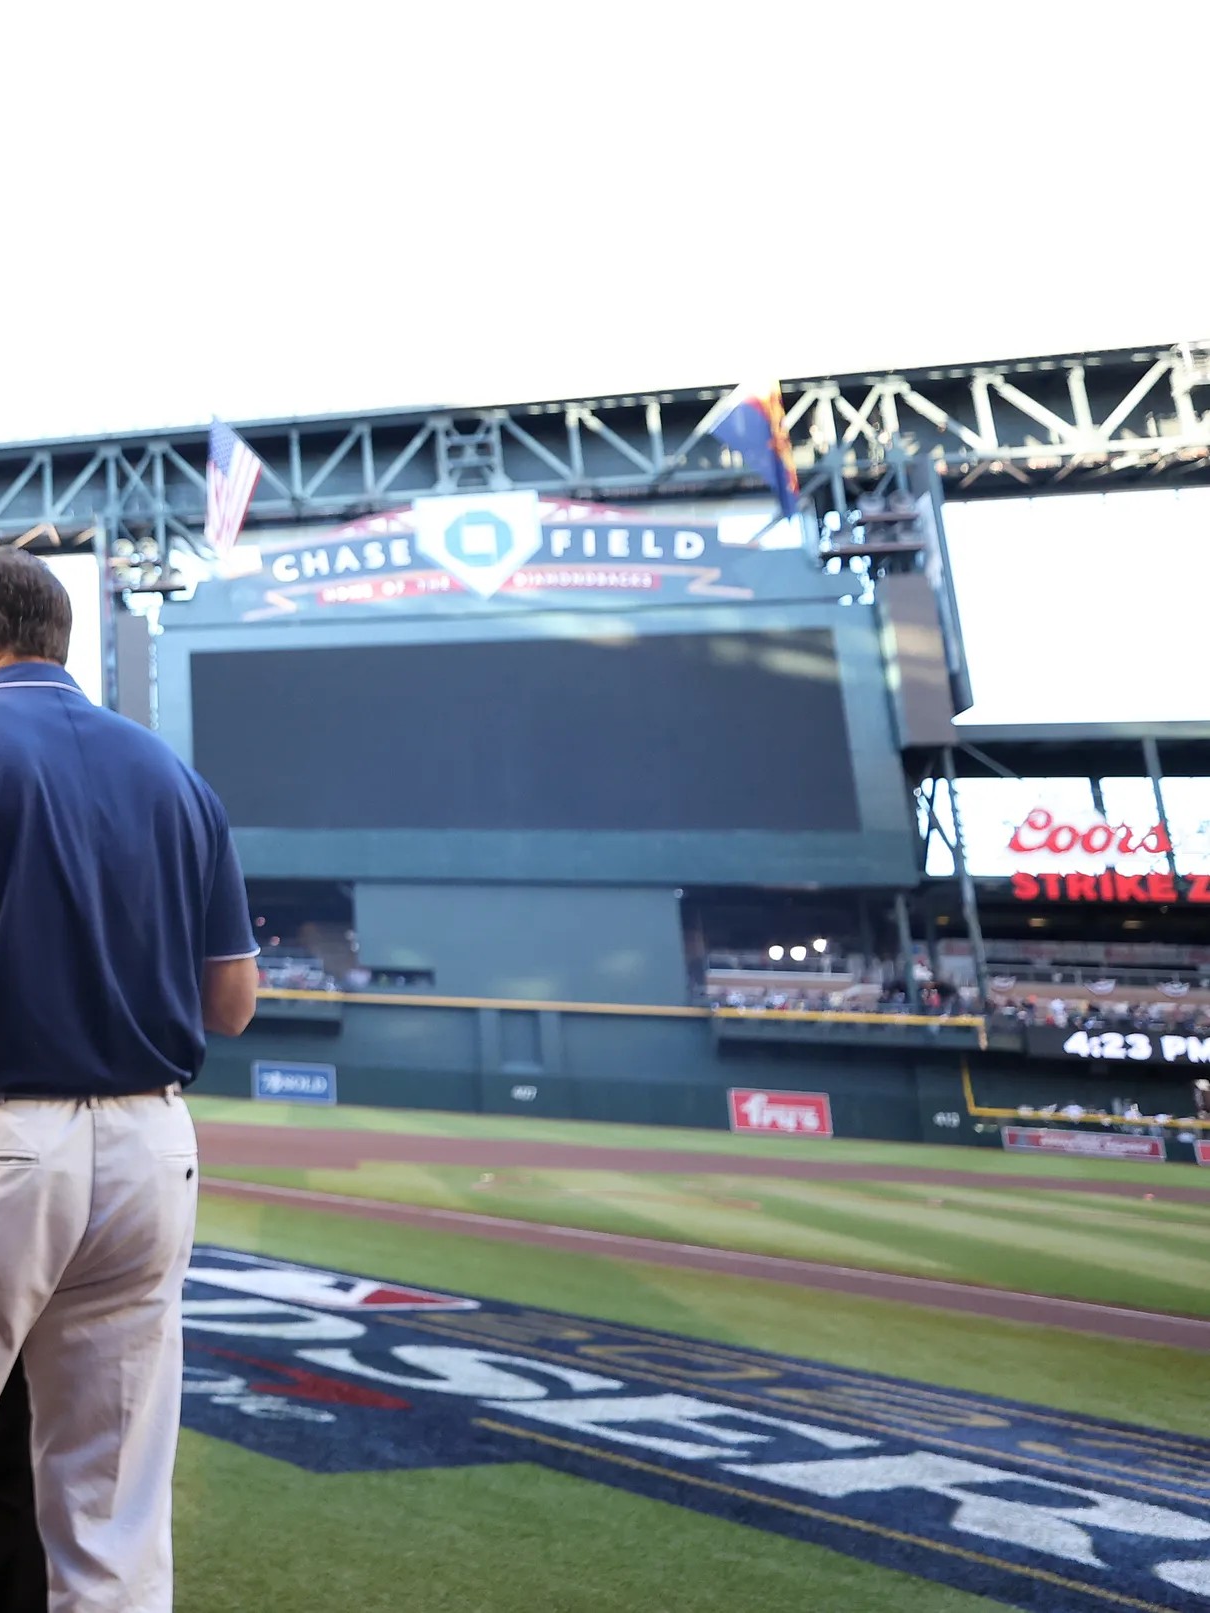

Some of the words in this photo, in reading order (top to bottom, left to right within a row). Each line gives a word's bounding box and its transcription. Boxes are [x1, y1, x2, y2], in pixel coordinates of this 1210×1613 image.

[272, 538, 412, 583] CHASE
[550, 528, 705, 560] FIELD
[1008, 808, 1174, 854] Coors
[1010, 871, 1178, 901] STRIKE
[1063, 1031, 1152, 1060] 4:23
